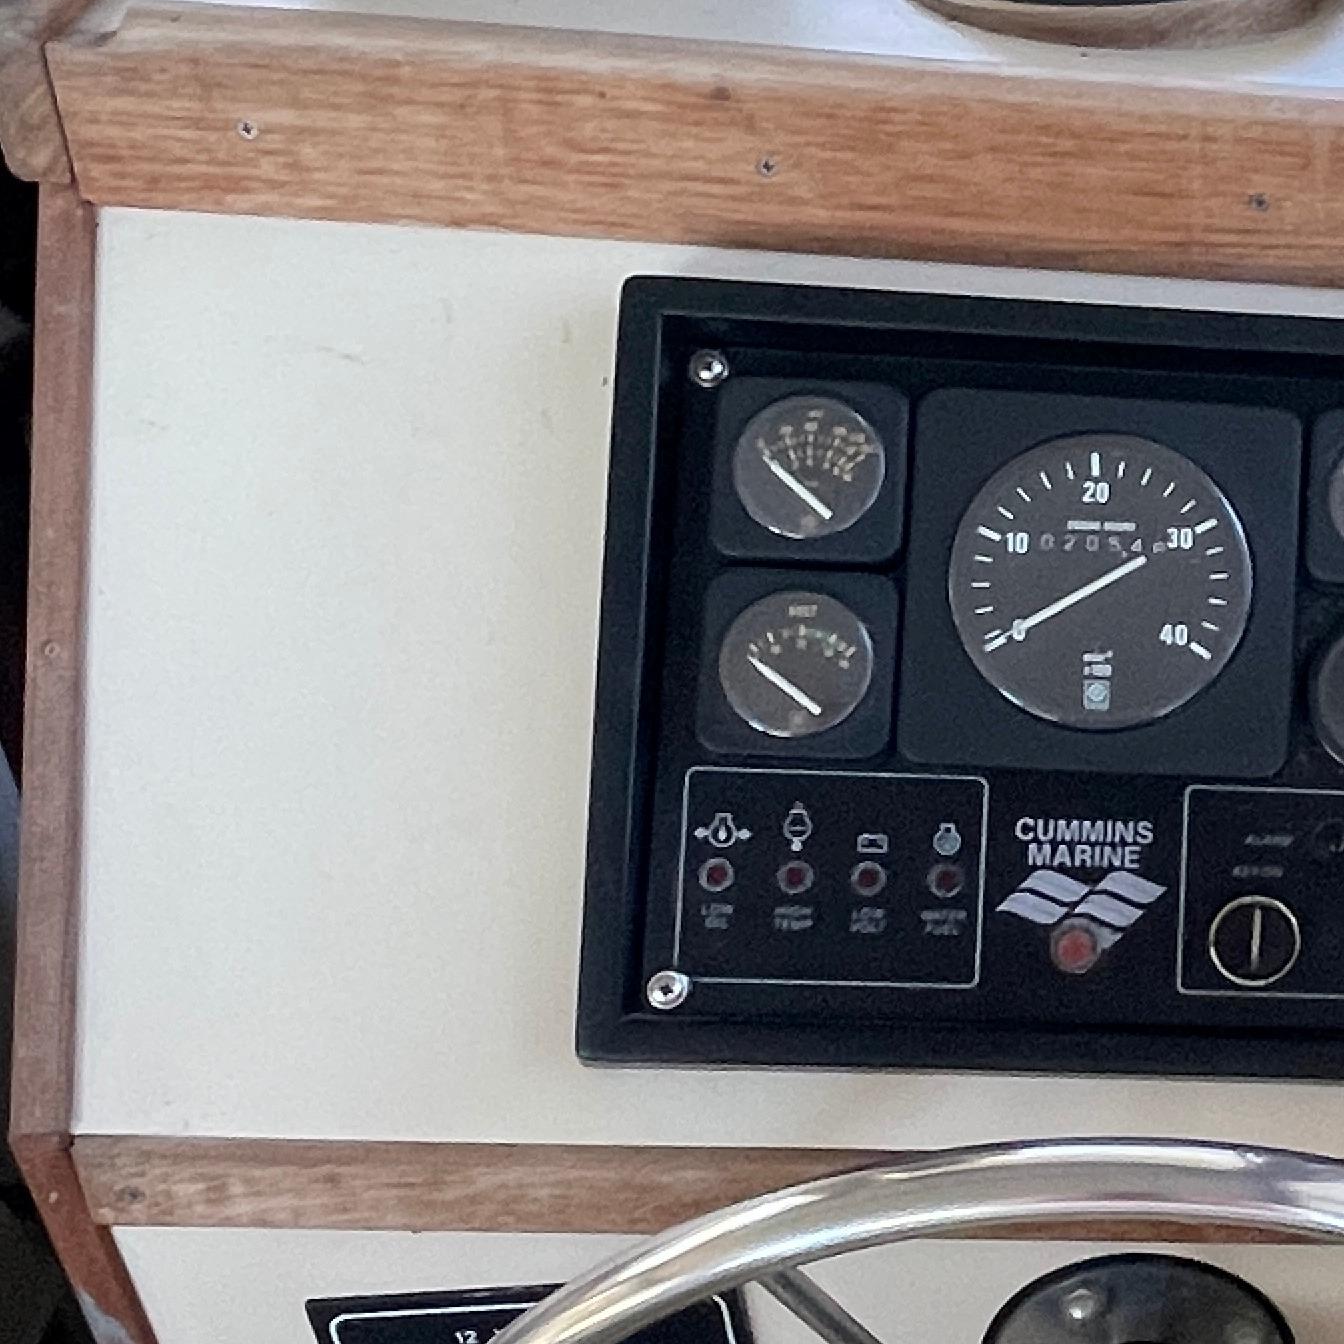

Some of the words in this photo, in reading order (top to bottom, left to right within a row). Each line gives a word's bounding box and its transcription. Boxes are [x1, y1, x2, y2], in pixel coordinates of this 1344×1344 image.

[1082, 481, 1110, 503] 20
[1007, 532, 1029, 553] 10
[1167, 527, 1194, 549] 30
[1159, 624, 1188, 645] 40
[1014, 816, 1154, 844] CUMMINS
[1028, 842, 1142, 868] MARINE
[454, 1330, 479, 1344] 12
